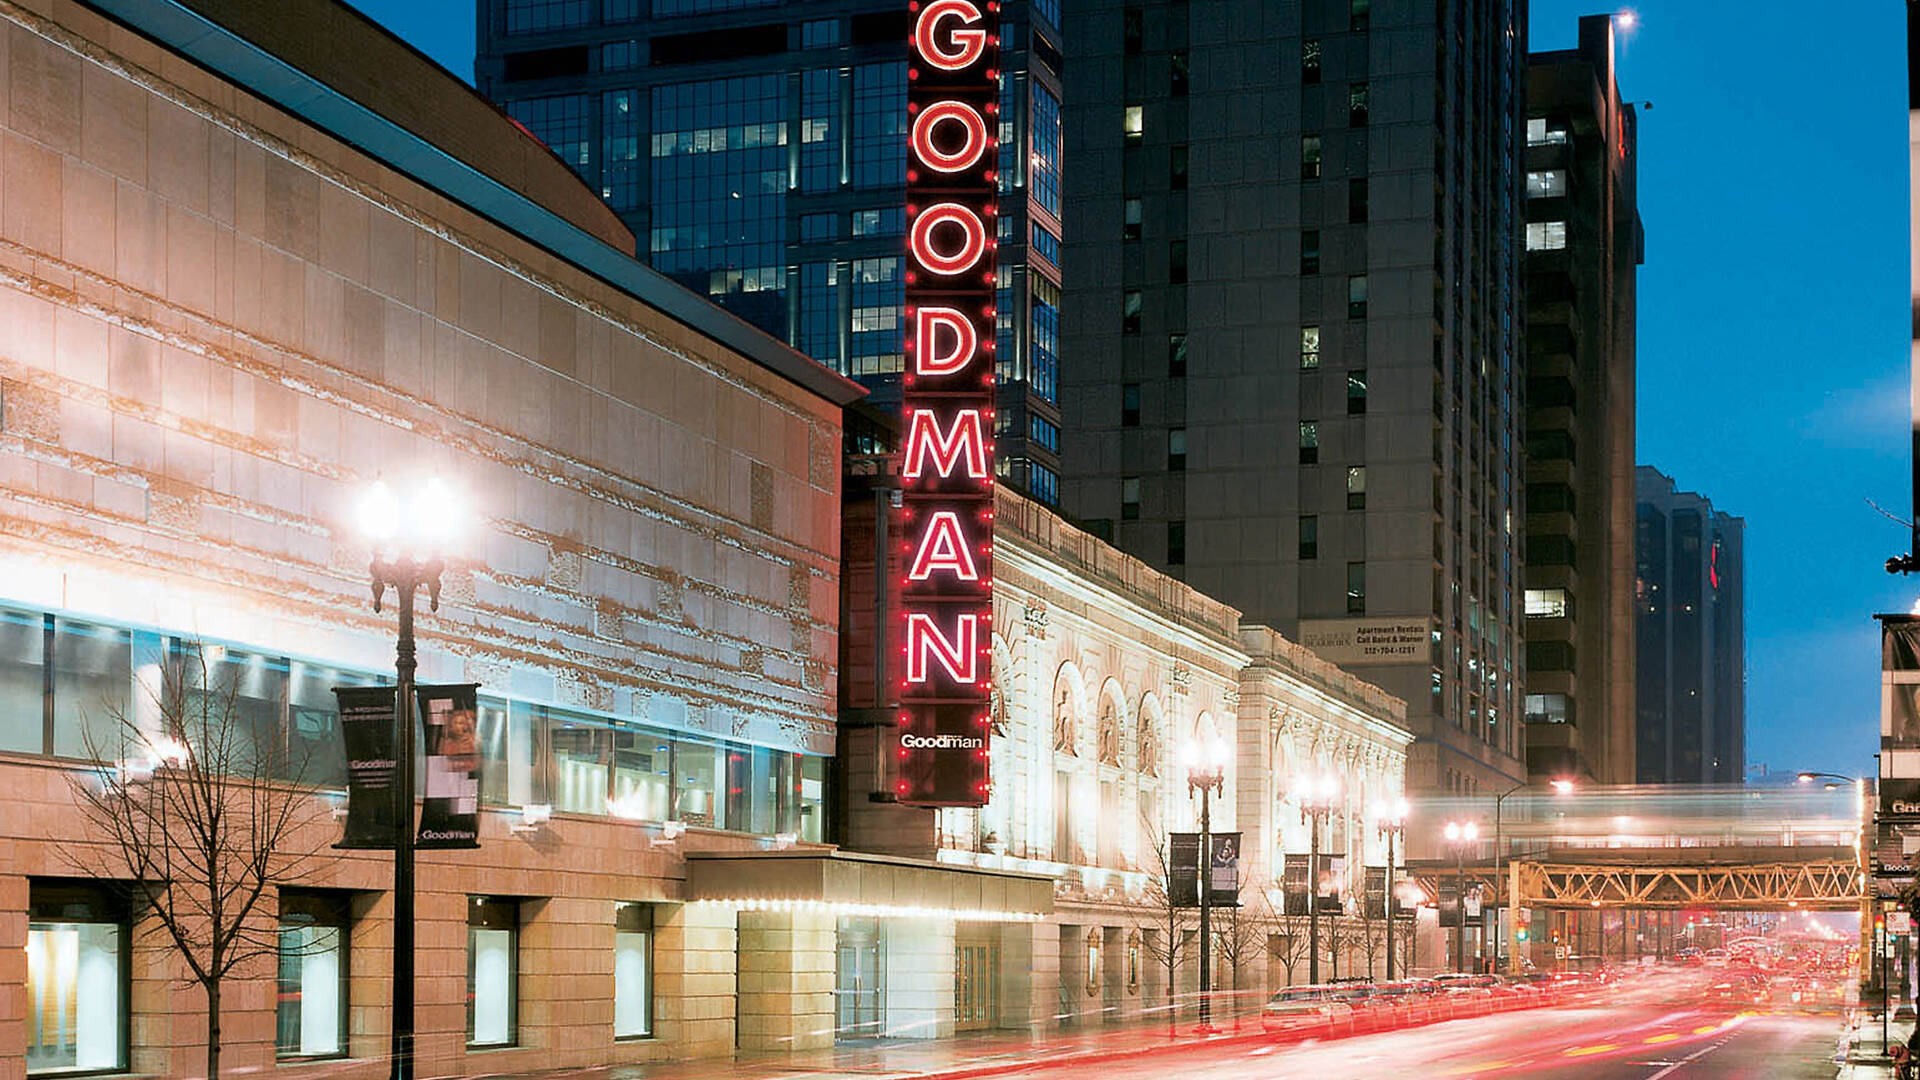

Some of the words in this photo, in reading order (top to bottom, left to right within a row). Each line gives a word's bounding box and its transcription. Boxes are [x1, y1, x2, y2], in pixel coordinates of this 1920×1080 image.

[903, 0, 987, 683] GOODMAN
[1356, 626, 1395, 635] Apartment
[1356, 635, 1371, 643] Call
[901, 734, 982, 748] Goodman
[422, 830, 476, 839] Goodman
[1884, 864, 1912, 872] Good
